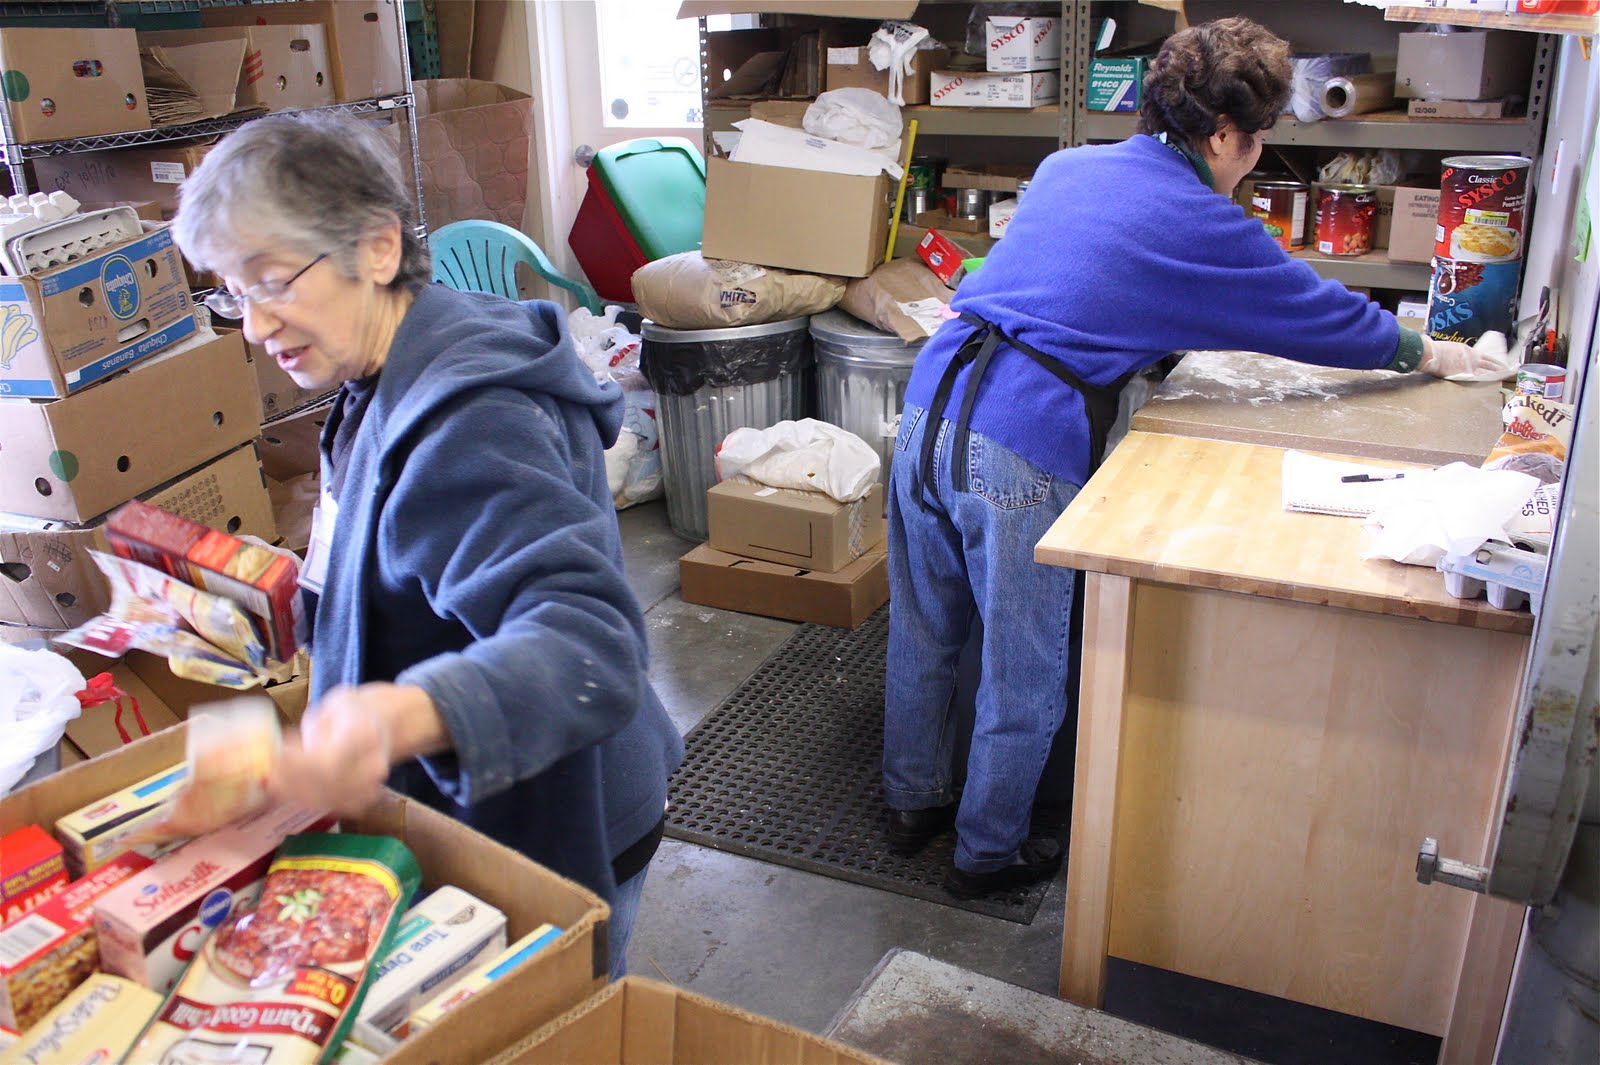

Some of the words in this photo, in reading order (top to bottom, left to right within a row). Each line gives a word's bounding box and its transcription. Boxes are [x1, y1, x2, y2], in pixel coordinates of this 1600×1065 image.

[991, 23, 1025, 51] SYSCO
[1034, 20, 1053, 47] SYSCO
[1093, 62, 1134, 74] Reynolds
[933, 77, 963, 101] SYSCO
[1405, 78, 1411, 86] 3
[1458, 170, 1517, 209] SYSCO
[1468, 175, 1498, 184] Classic
[106, 272, 134, 292] Chiquita
[138, 333, 169, 353] Chiquita
[102, 350, 134, 370] Bananas
[410, 929, 449, 951] Tuna
